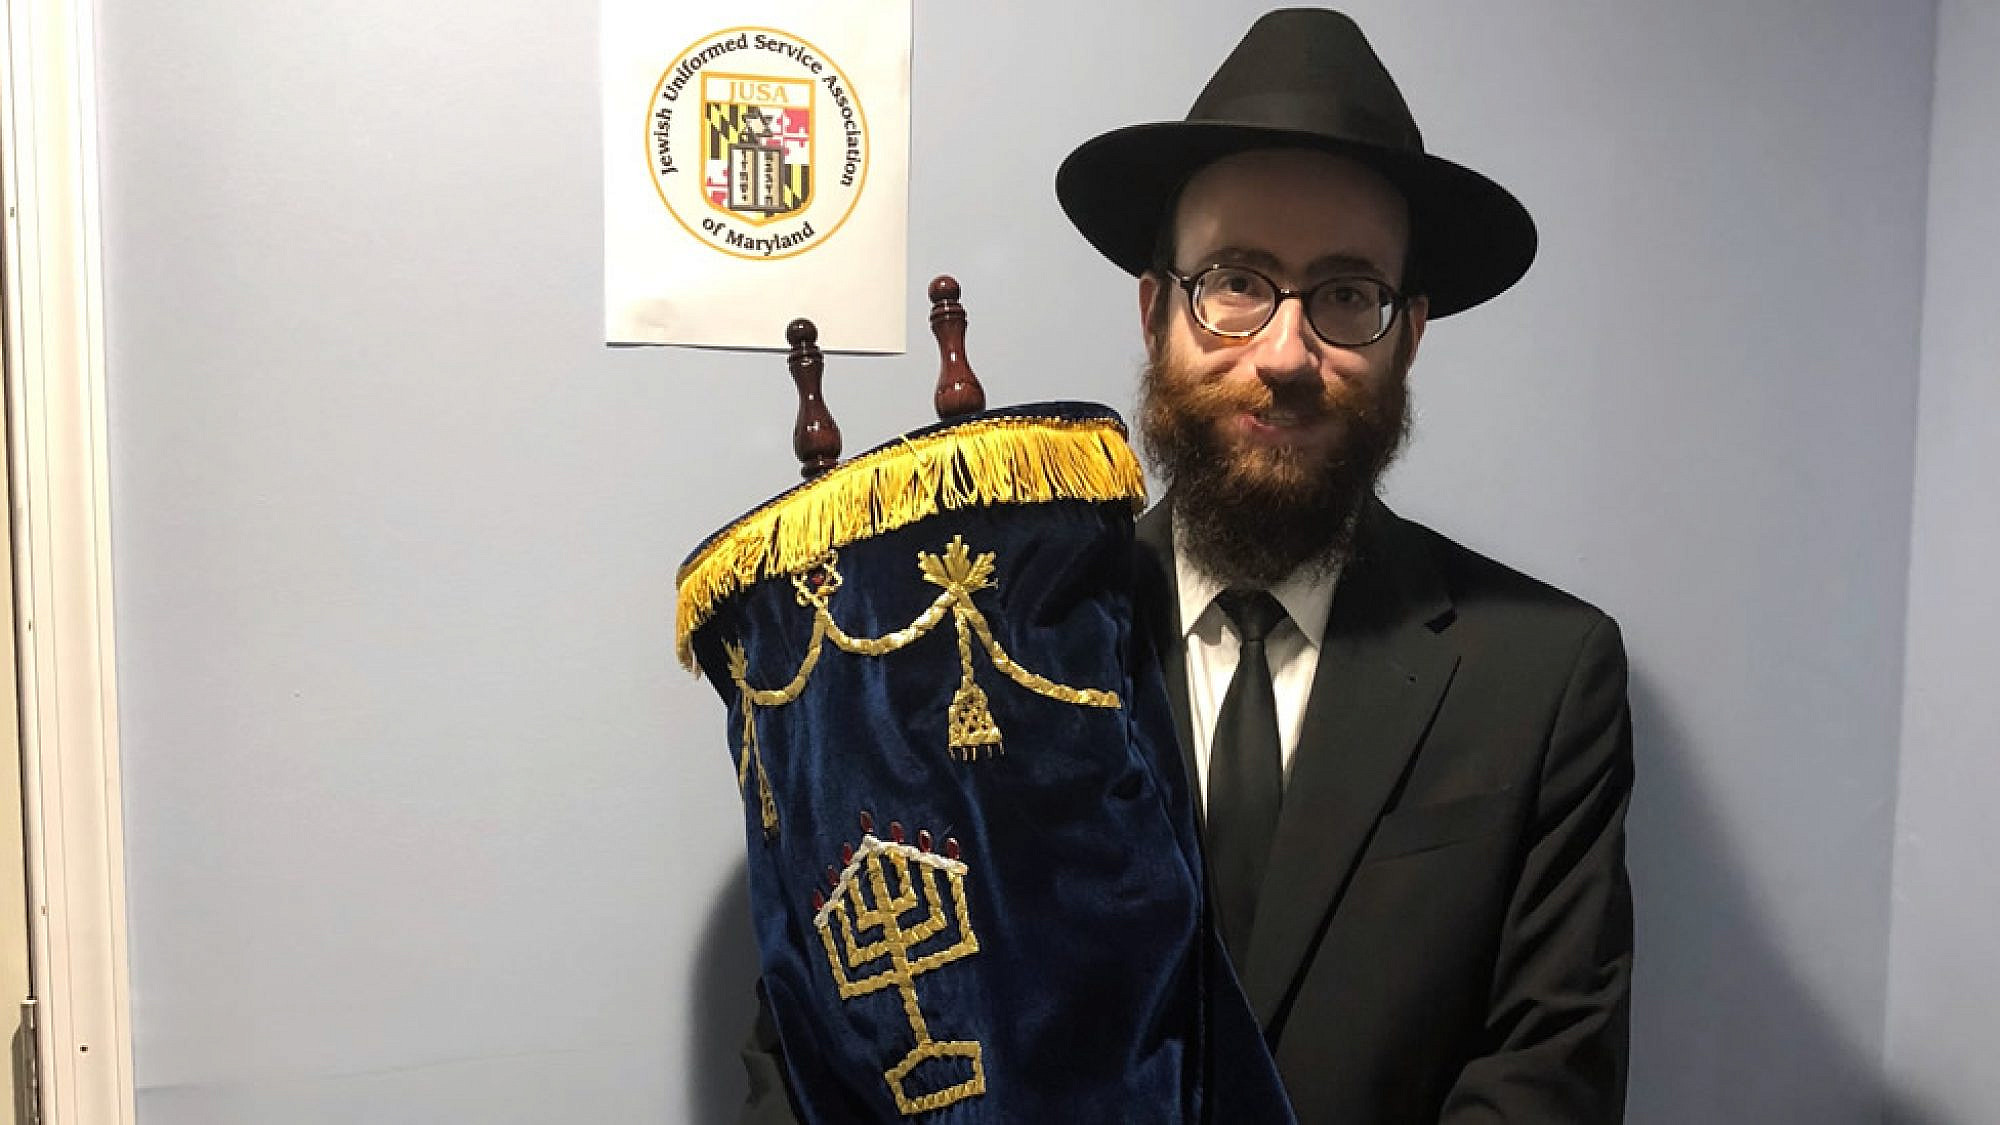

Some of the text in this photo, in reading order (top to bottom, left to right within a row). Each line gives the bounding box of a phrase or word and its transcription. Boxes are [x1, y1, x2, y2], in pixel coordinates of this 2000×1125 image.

[662, 33, 748, 102] Uniformed
[753, 34, 823, 74] Service
[728, 81, 788, 103] JUSA
[653, 107, 679, 175] Jewish
[821, 75, 862, 187] Association
[702, 217, 815, 256] of Maryland
